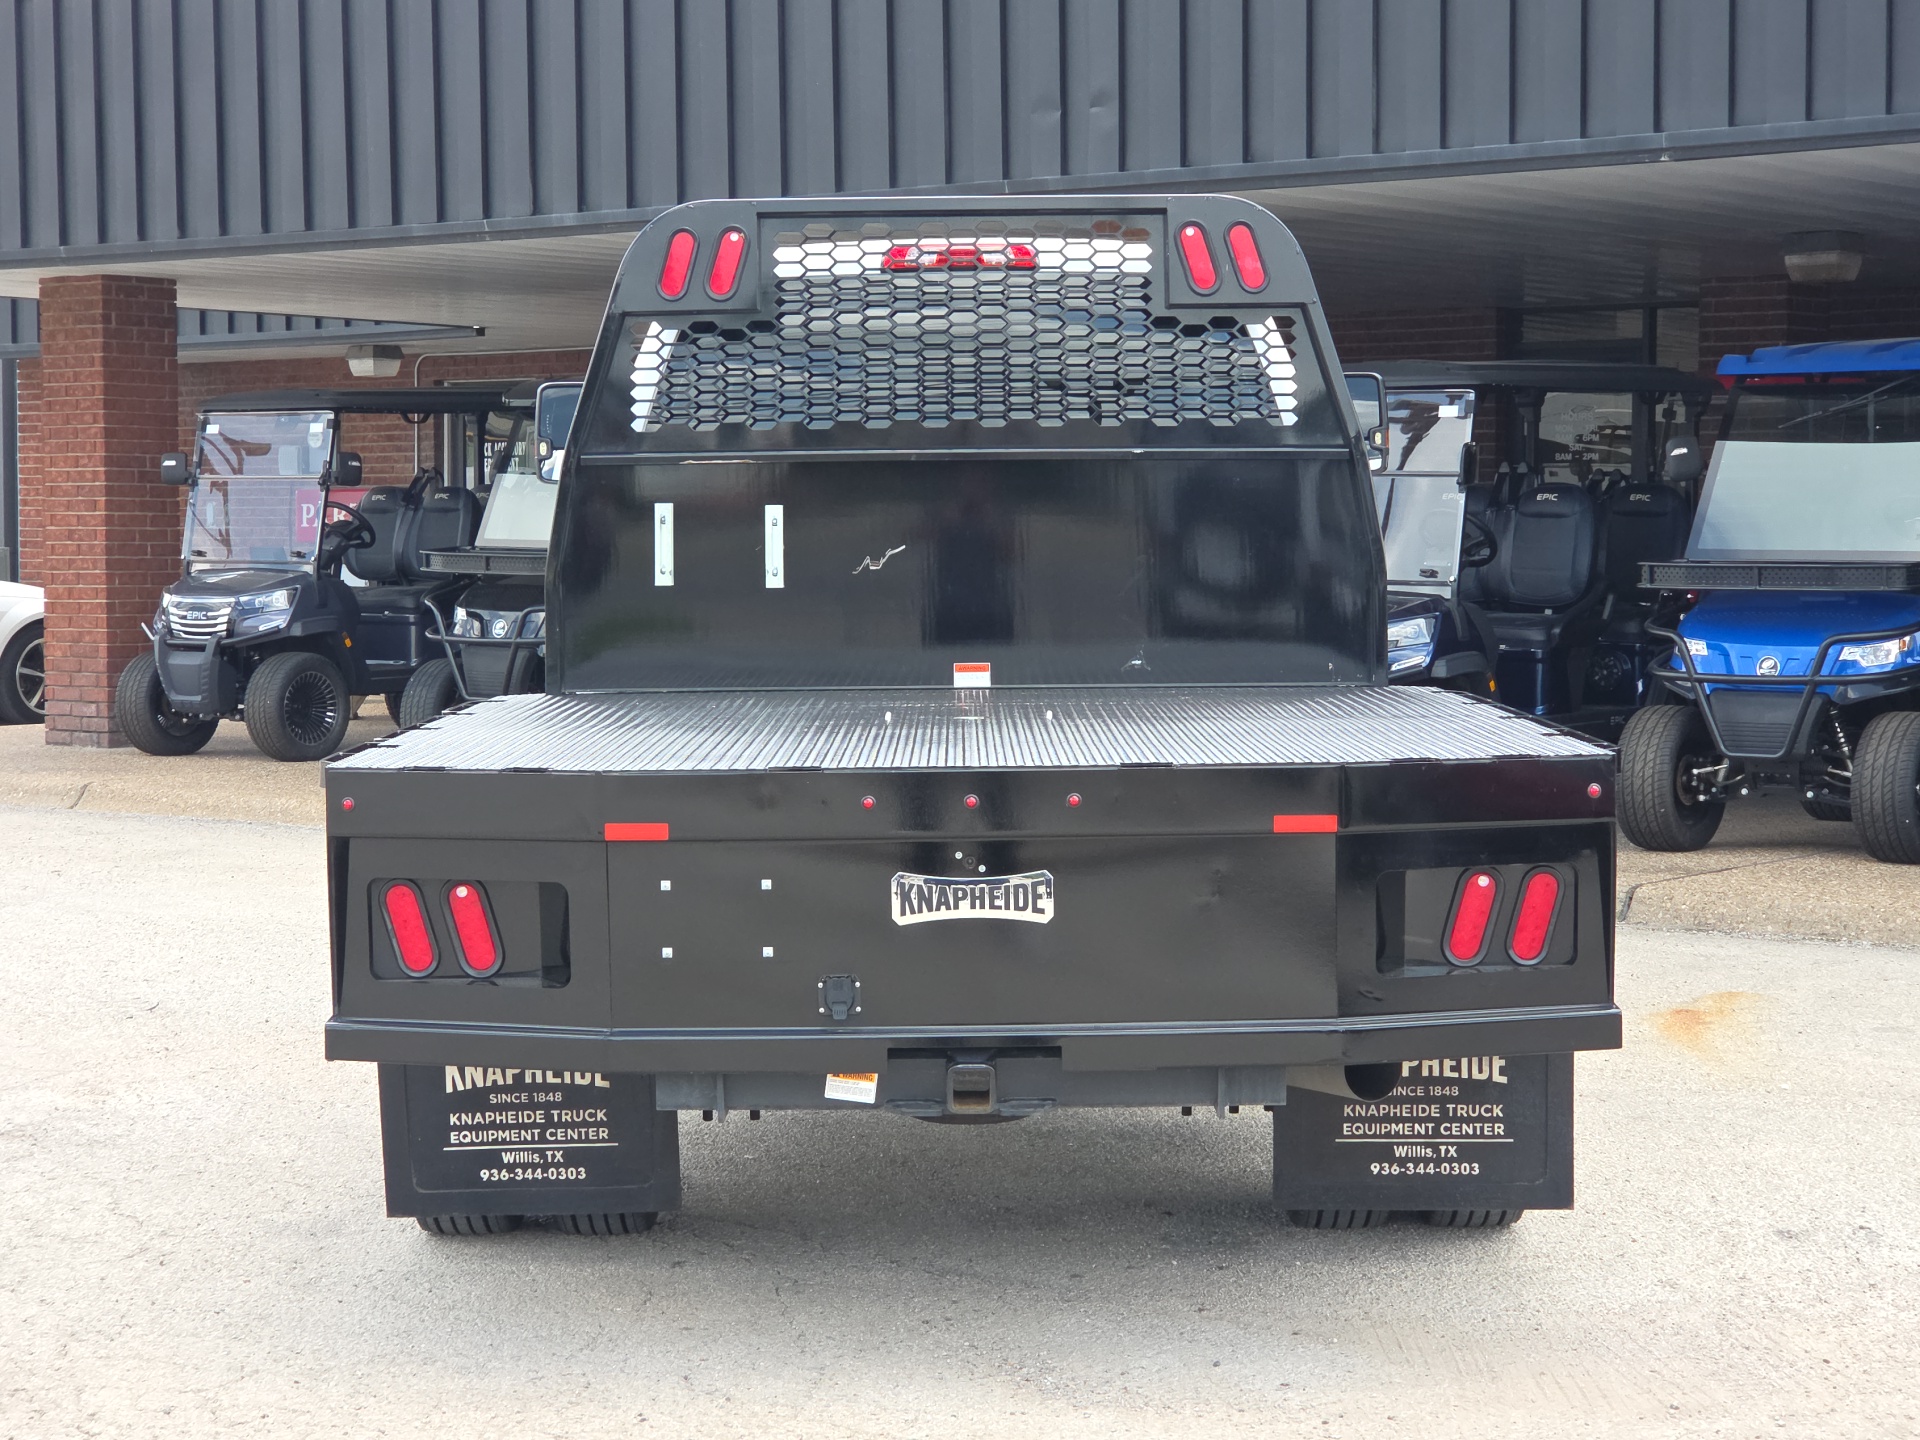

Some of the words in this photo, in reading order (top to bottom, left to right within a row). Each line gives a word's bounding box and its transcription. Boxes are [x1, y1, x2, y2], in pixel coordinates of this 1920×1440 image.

[1582, 434, 1600, 442] 6PM
[1536, 493, 1559, 501] EPIC
[1629, 493, 1651, 502] EPIC
[186, 611, 207, 620] EPIC
[899, 879, 1046, 917] KNAPHEIDE
[1429, 1086, 1459, 1096] 1848
[489, 1093, 529, 1104] SINCE
[533, 1092, 562, 1103] 1848
[450, 1110, 545, 1126] KNAPHEIDE
[551, 1108, 608, 1123] TRUCK
[1343, 1104, 1441, 1117] KNAPHEIDE
[1446, 1104, 1504, 1117] TRUCK
[450, 1129, 541, 1144] EQUIPMENT
[546, 1127, 609, 1140] CENTER
[1343, 1123, 1435, 1135] EQUIPMENT
[1440, 1123, 1505, 1135] CENTER
[501, 1151, 544, 1164] Willis,
[545, 1151, 564, 1163] TX
[1394, 1145, 1437, 1159] Willis,
[1439, 1145, 1458, 1158] TX
[480, 1167, 587, 1181] 936-344-0303
[1370, 1162, 1480, 1175] 936-344-0303
